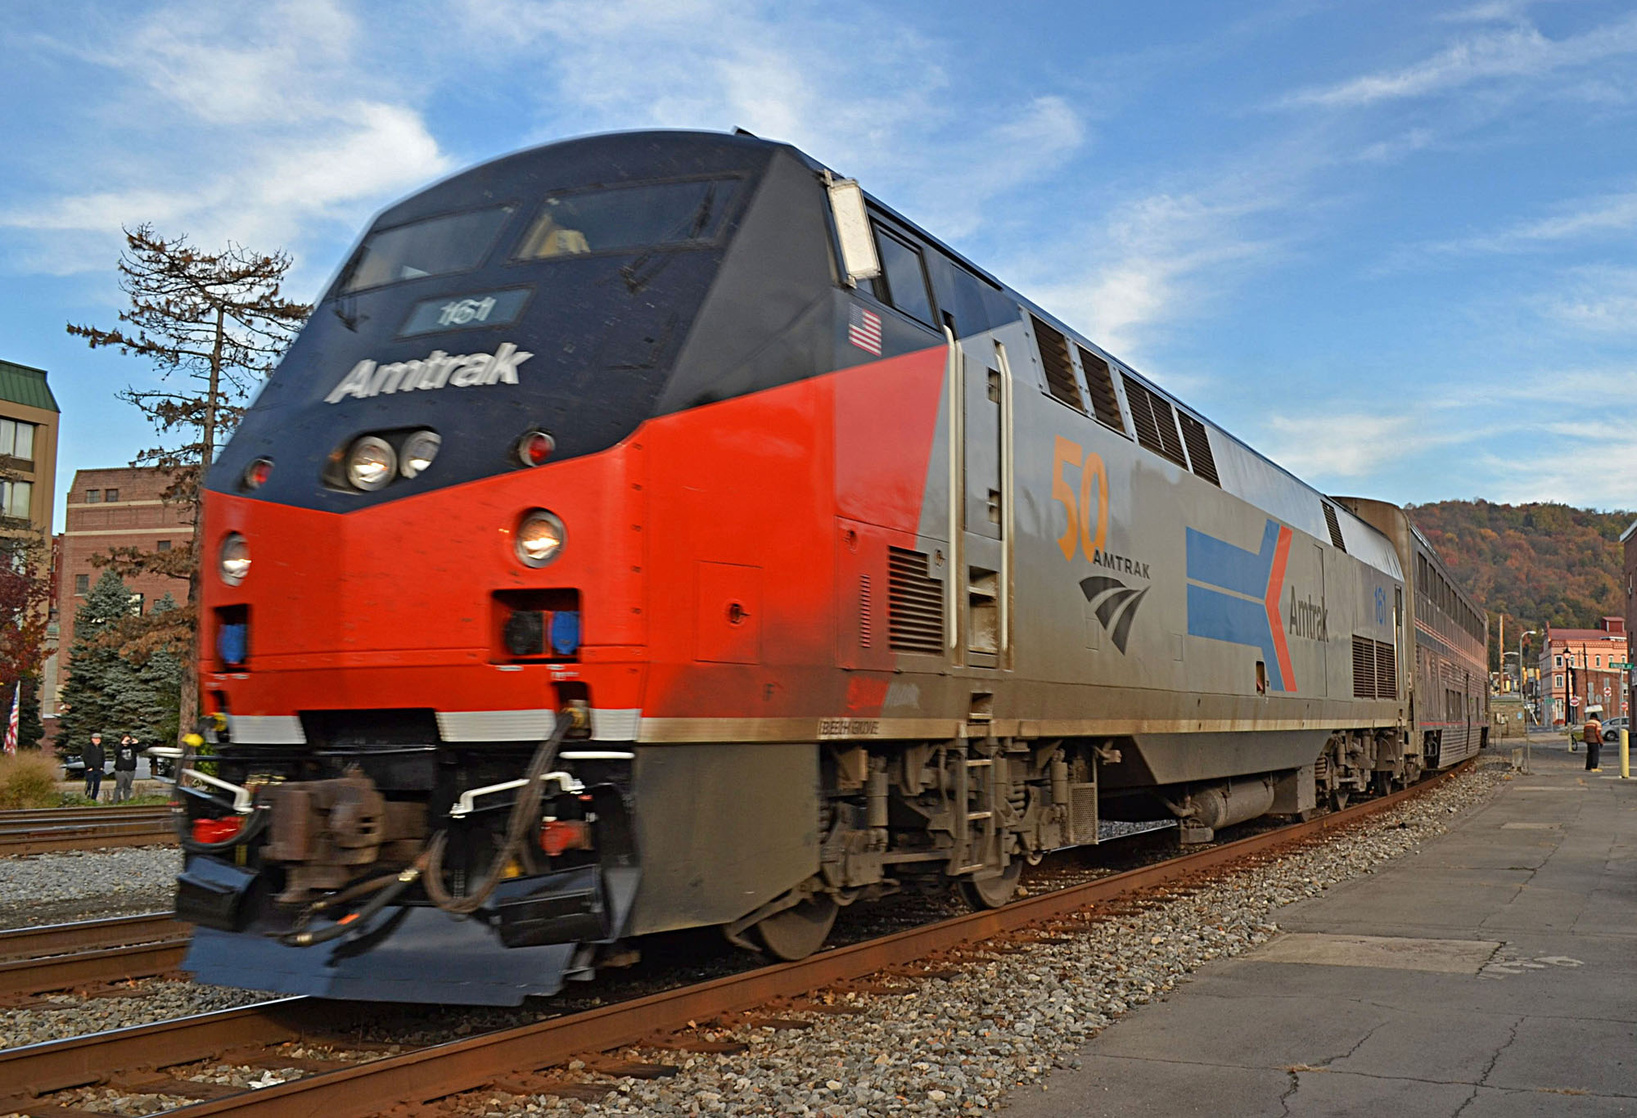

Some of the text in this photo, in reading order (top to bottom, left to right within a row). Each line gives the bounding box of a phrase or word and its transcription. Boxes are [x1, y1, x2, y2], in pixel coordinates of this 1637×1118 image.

[438, 296, 497, 326] 161
[323, 342, 535, 404] Amtrak
[1052, 434, 1109, 564] 50
[1092, 549, 1151, 580] AMTRAK
[1289, 585, 1330, 643] Amtrak
